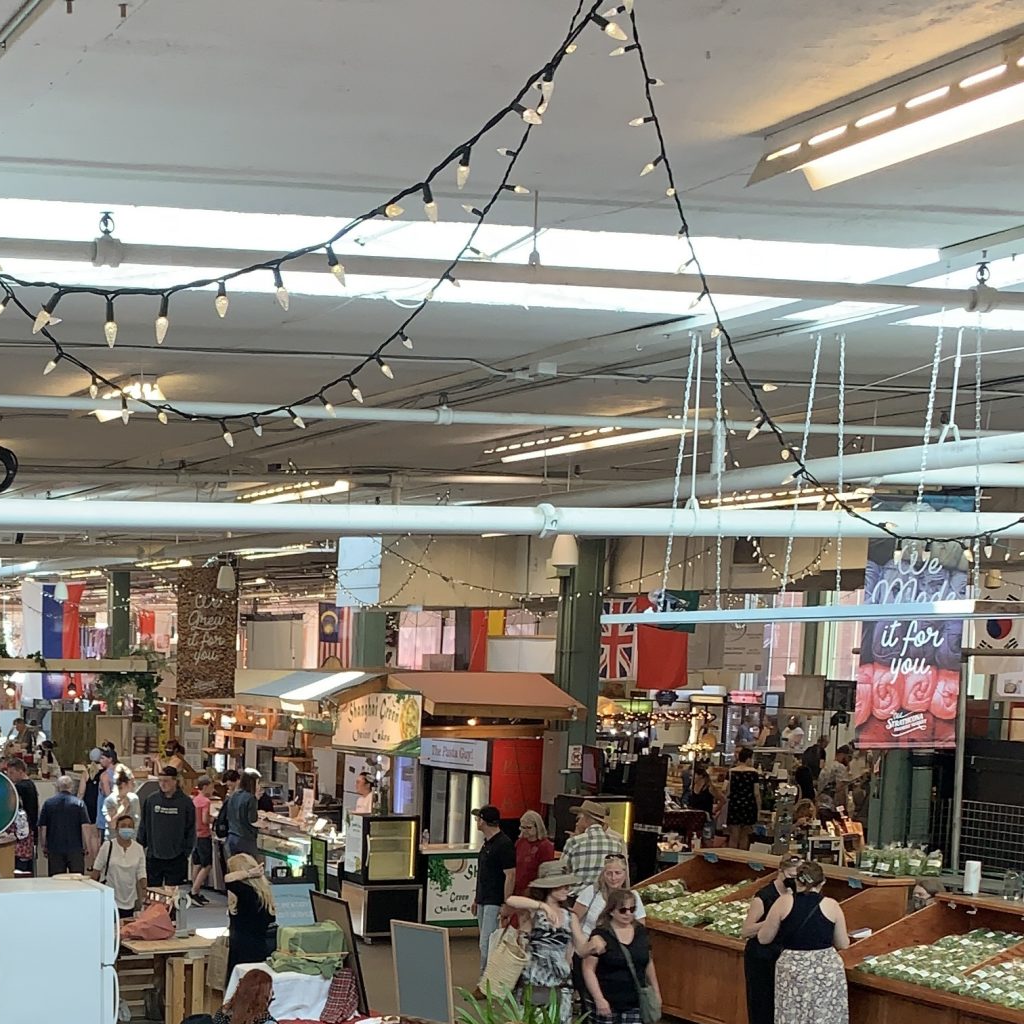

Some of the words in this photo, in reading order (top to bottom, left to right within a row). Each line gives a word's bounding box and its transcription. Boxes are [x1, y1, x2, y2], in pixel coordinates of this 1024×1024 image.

[897, 544, 943, 575] We
[195, 593, 222, 608] We
[188, 610, 226, 631] Grew
[187, 632, 199, 646] it
[200, 632, 226, 651] for
[880, 620, 901, 648] it
[899, 620, 945, 657] for
[890, 657, 933, 685] you.
[347, 696, 379, 723] Shanghai
[379, 698, 400, 723] Green
[352, 728, 371, 742] Onion
[372, 728, 390, 743] Cakes
[431, 744, 442, 756] The
[443, 746, 458, 758] Pasta
[449, 891, 470, 903] Green
[434, 904, 458, 915] Onion
